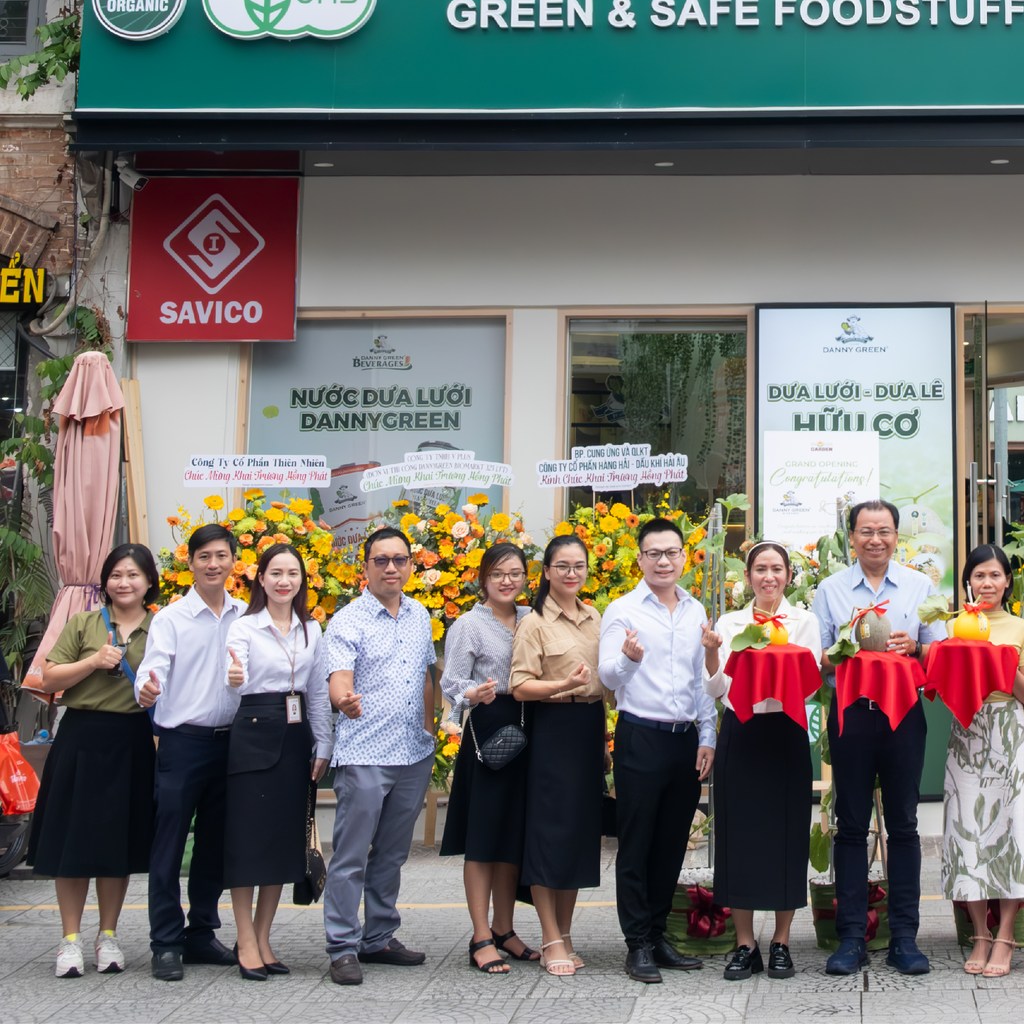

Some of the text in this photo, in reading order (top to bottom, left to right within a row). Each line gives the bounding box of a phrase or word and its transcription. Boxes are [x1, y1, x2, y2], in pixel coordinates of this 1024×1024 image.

[159, 300, 263, 325] SAVICO
[290, 382, 472, 408] NƯỚC DƯA LƯỚI
[767, 378, 944, 400] DƯA LƯỚI DƯA LÊ
[300, 411, 461, 432] DANNYGREEN
[872, 407, 921, 438] CƠ
[587, 448, 605, 458] CUNG
[621, 446, 630, 456] VÀ
[191, 457, 214, 468] Công
[218, 458, 230, 469] Ty
[300, 457, 325, 468] Nhiên
[539, 461, 557, 472] CÔNG
[559, 463, 567, 472] TY
[785, 460, 858, 468] GRAND OPENING
[184, 469, 204, 481] Chúc
[769, 467, 874, 488] Congratulations!
